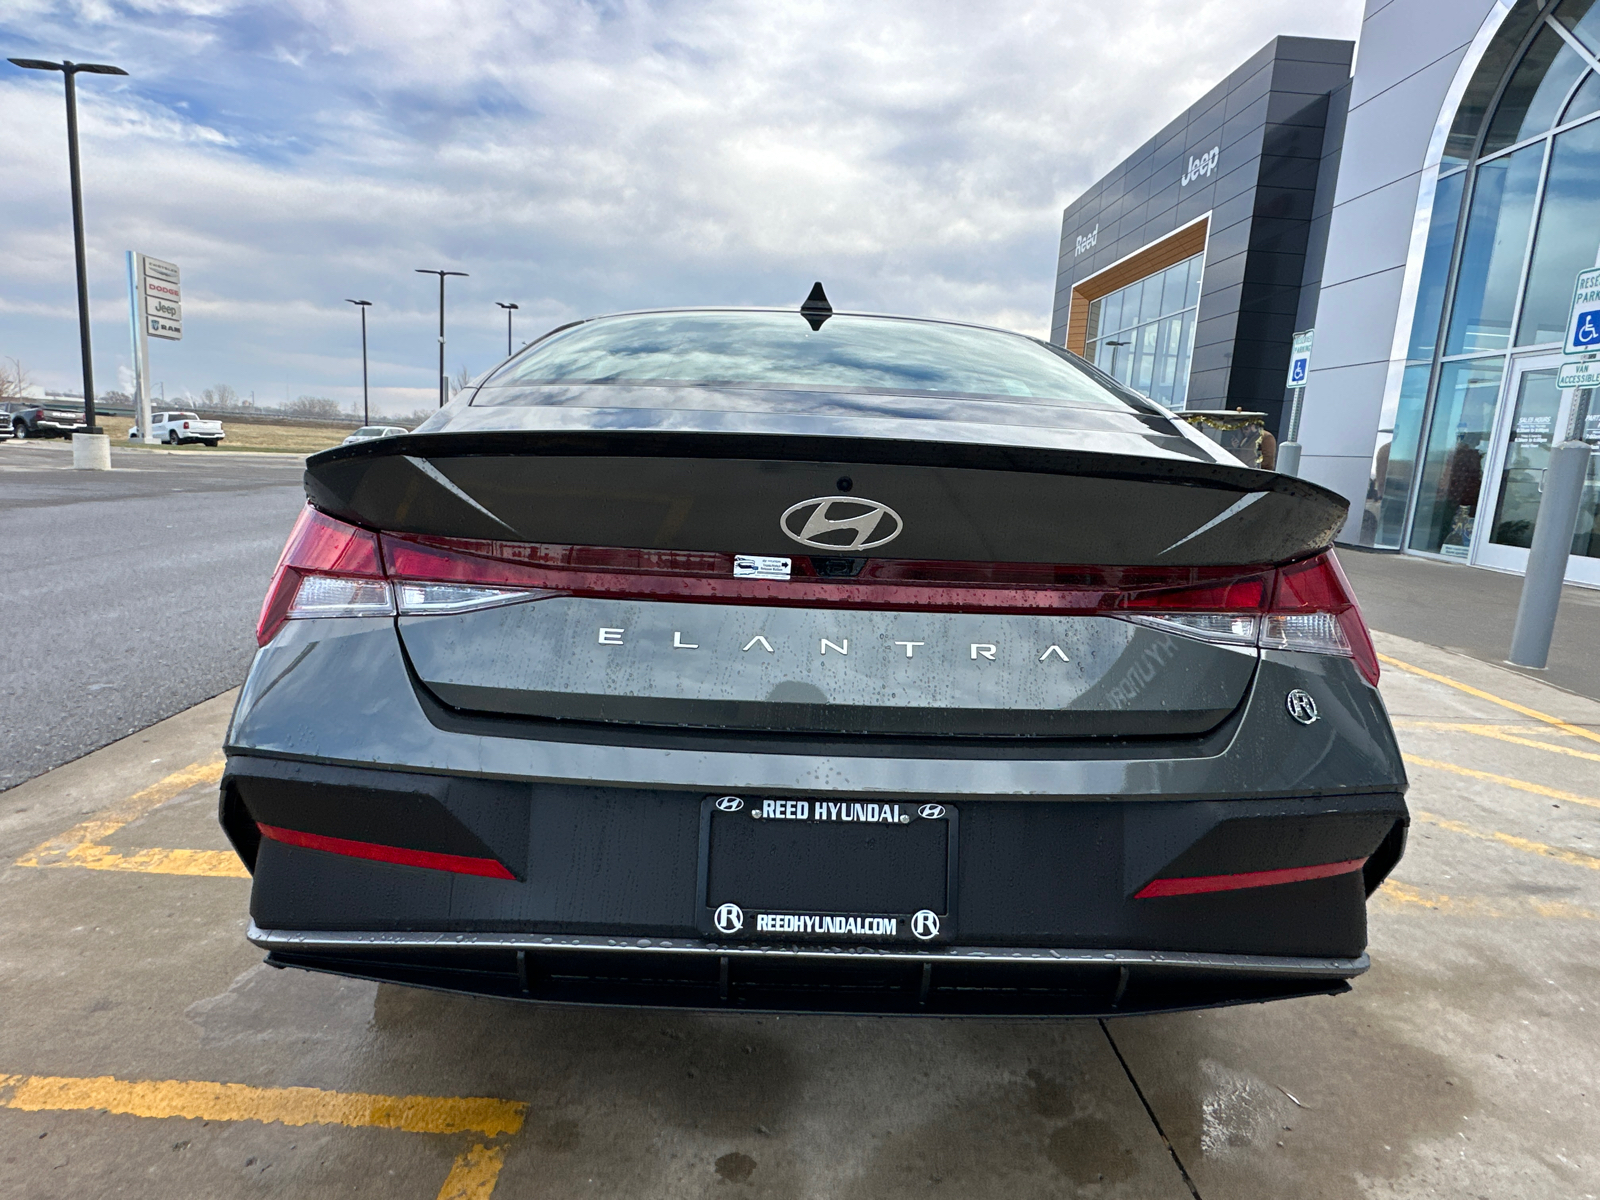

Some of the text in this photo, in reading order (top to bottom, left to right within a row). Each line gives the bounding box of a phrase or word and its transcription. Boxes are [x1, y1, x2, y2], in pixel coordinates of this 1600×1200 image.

[1181, 146, 1220, 186] Jeep
[1074, 223, 1099, 257] Reed
[149, 283, 180, 296] DODGE
[1580, 274, 1600, 289] RESE
[155, 301, 177, 317] Jeep
[160, 324, 181, 333] RAM
[1575, 365, 1589, 373] VAN
[1560, 373, 1600, 384] ACCESSIBLE
[598, 627, 1070, 662] ELANTRA
[762, 799, 899, 823] REED HYUNDAI
[757, 914, 897, 936] REEDHYUNDAI.COM
